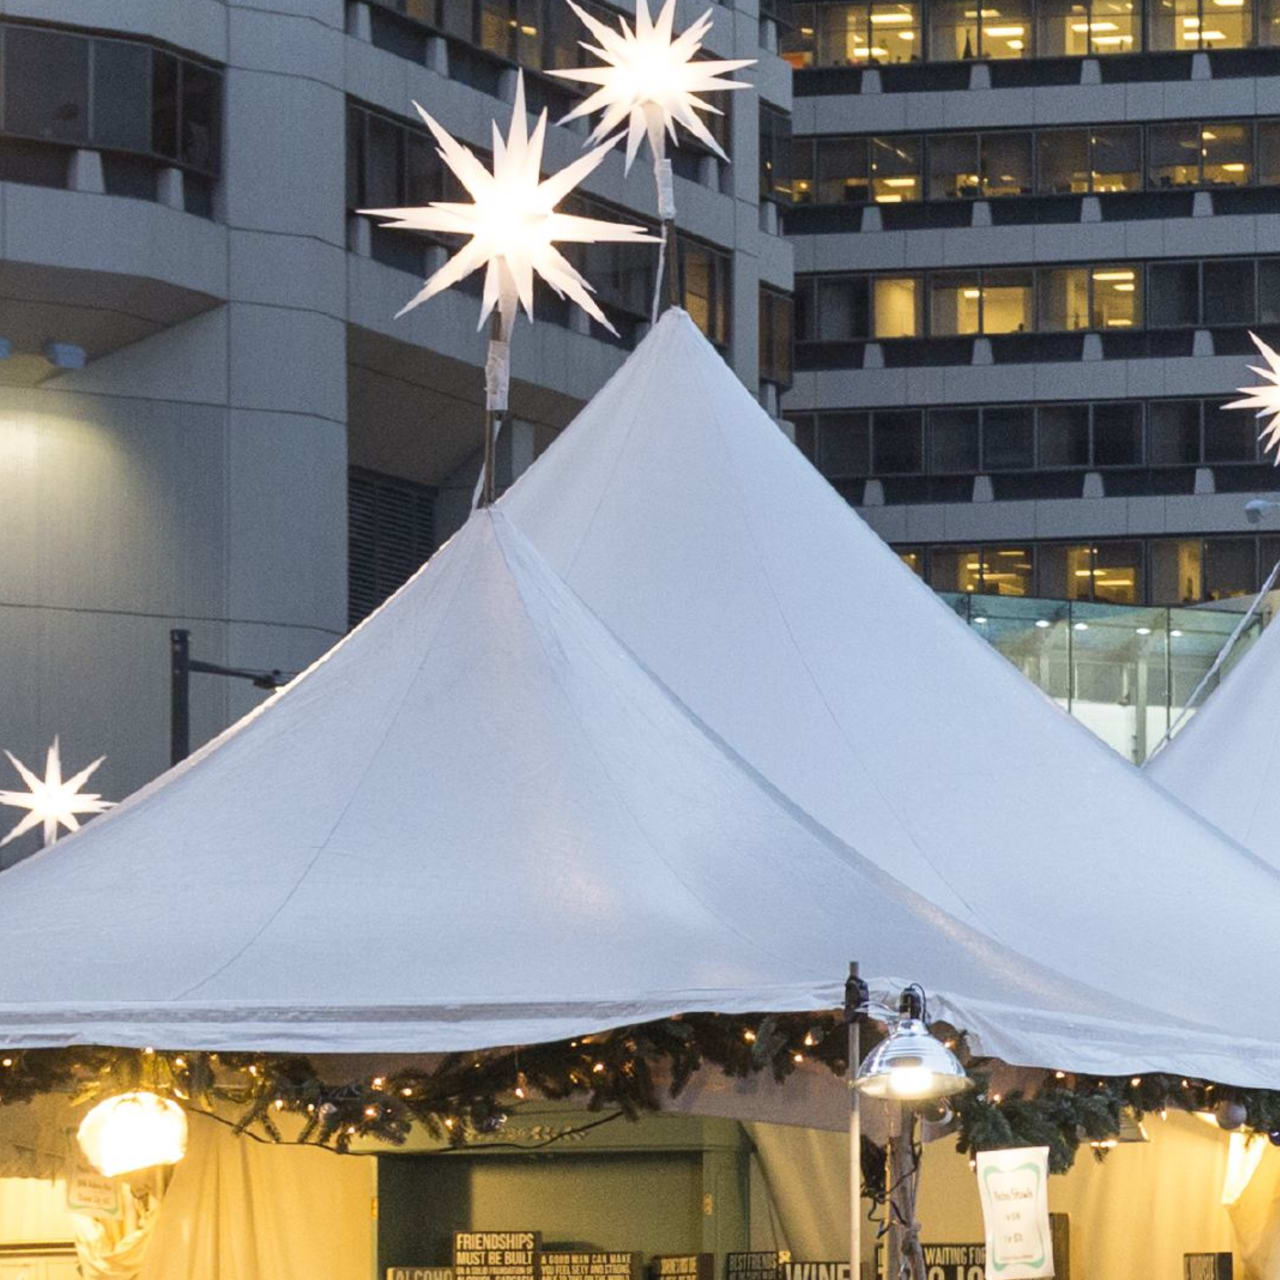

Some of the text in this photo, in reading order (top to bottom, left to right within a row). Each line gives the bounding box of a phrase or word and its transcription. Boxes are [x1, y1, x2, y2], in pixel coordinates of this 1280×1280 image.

[456, 1233, 534, 1250] FRIENDSHIPS
[456, 1251, 534, 1265] MUST BE BUILT
[923, 1247, 967, 1265] WAITING
